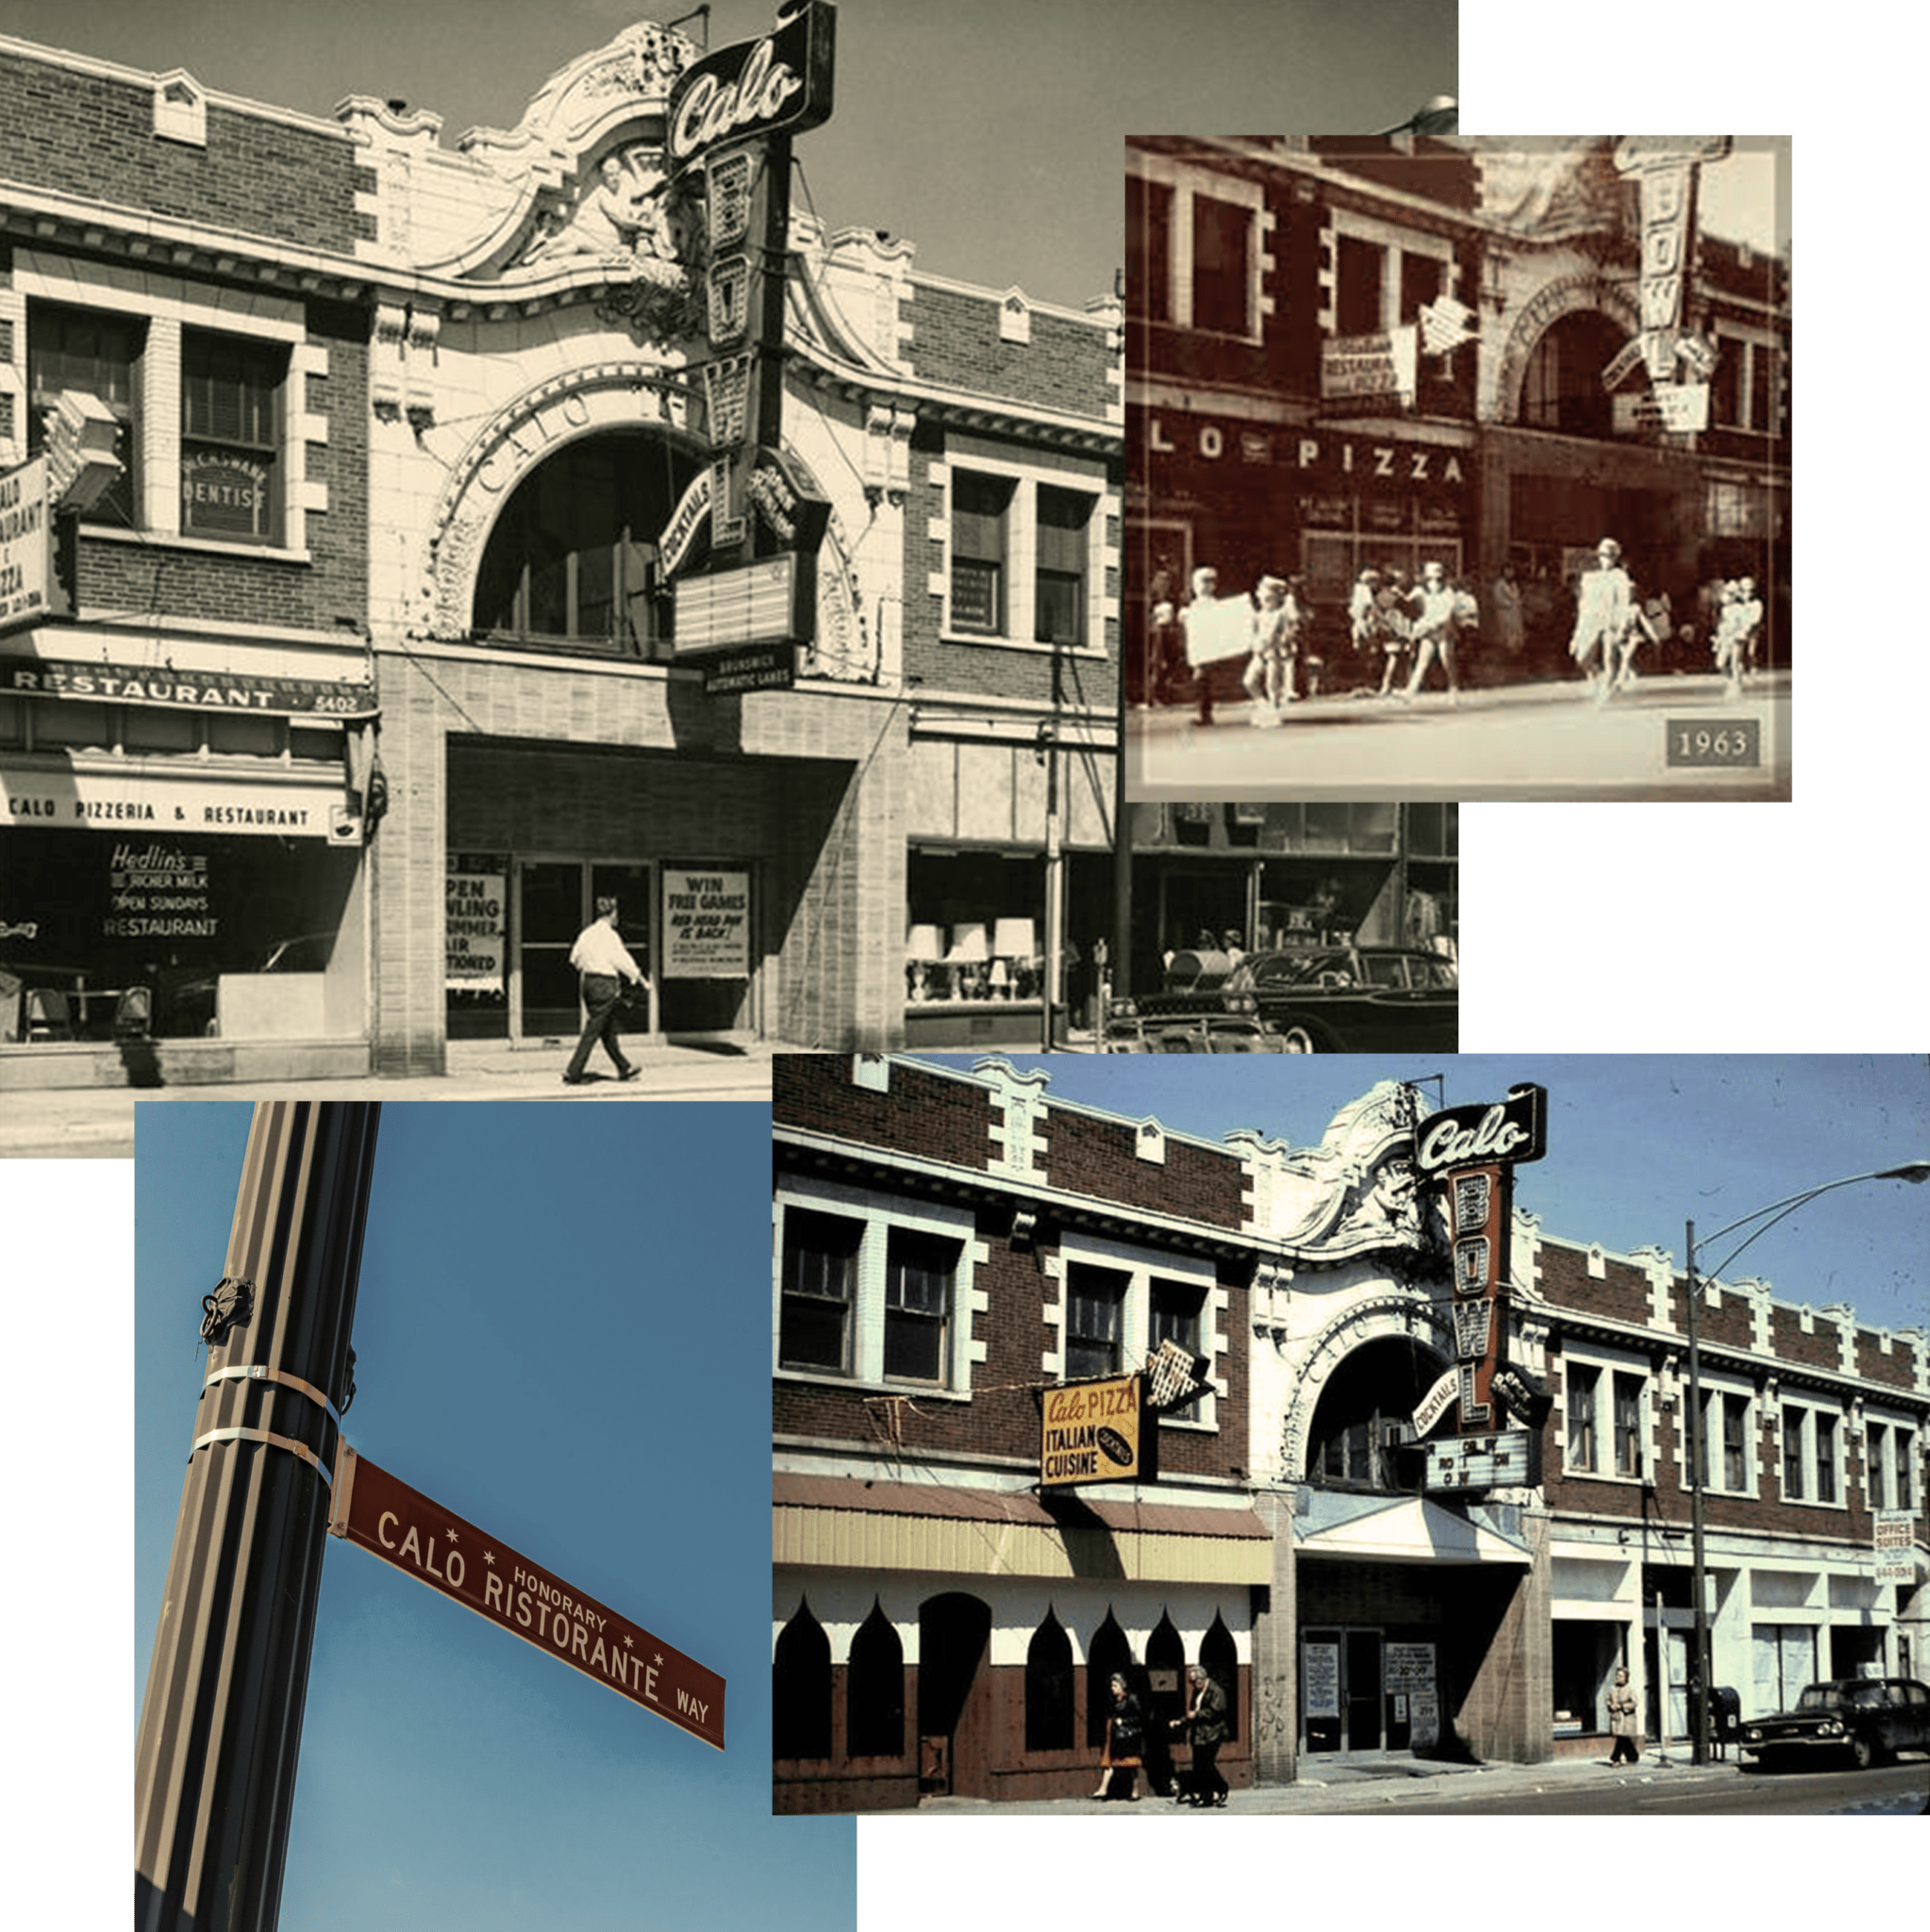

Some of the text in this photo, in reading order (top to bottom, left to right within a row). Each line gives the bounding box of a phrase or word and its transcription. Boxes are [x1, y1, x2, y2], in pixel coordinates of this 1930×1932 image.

[674, 38, 802, 158] Calo
[704, 152, 753, 548] BOWL
[477, 392, 590, 492] CALO
[1299, 439, 1462, 483] PIZZA
[183, 481, 266, 509] DENTIST
[14, 671, 358, 712] RESTAURANT 5402
[8, 798, 309, 825] CALO PIZZERIA & RESTAURANT
[668, 893, 746, 910] FREE GAMES
[685, 876, 724, 893] WIN
[103, 917, 219, 937] RESTAURANT
[1420, 1104, 1530, 1170] Calo
[1452, 1174, 1495, 1423] BOWL
[1048, 1385, 1138, 1424] Calo PIZZA
[1416, 1377, 1457, 1431] COCKTAILS
[1046, 1423, 1097, 1452] ITALIAN
[1046, 1451, 1098, 1478] CUISINE
[1875, 1523, 1912, 1536] OFFICE
[378, 1511, 709, 1724] CALO RISTORANTE WAY
[514, 1566, 607, 1634] HONORARY
